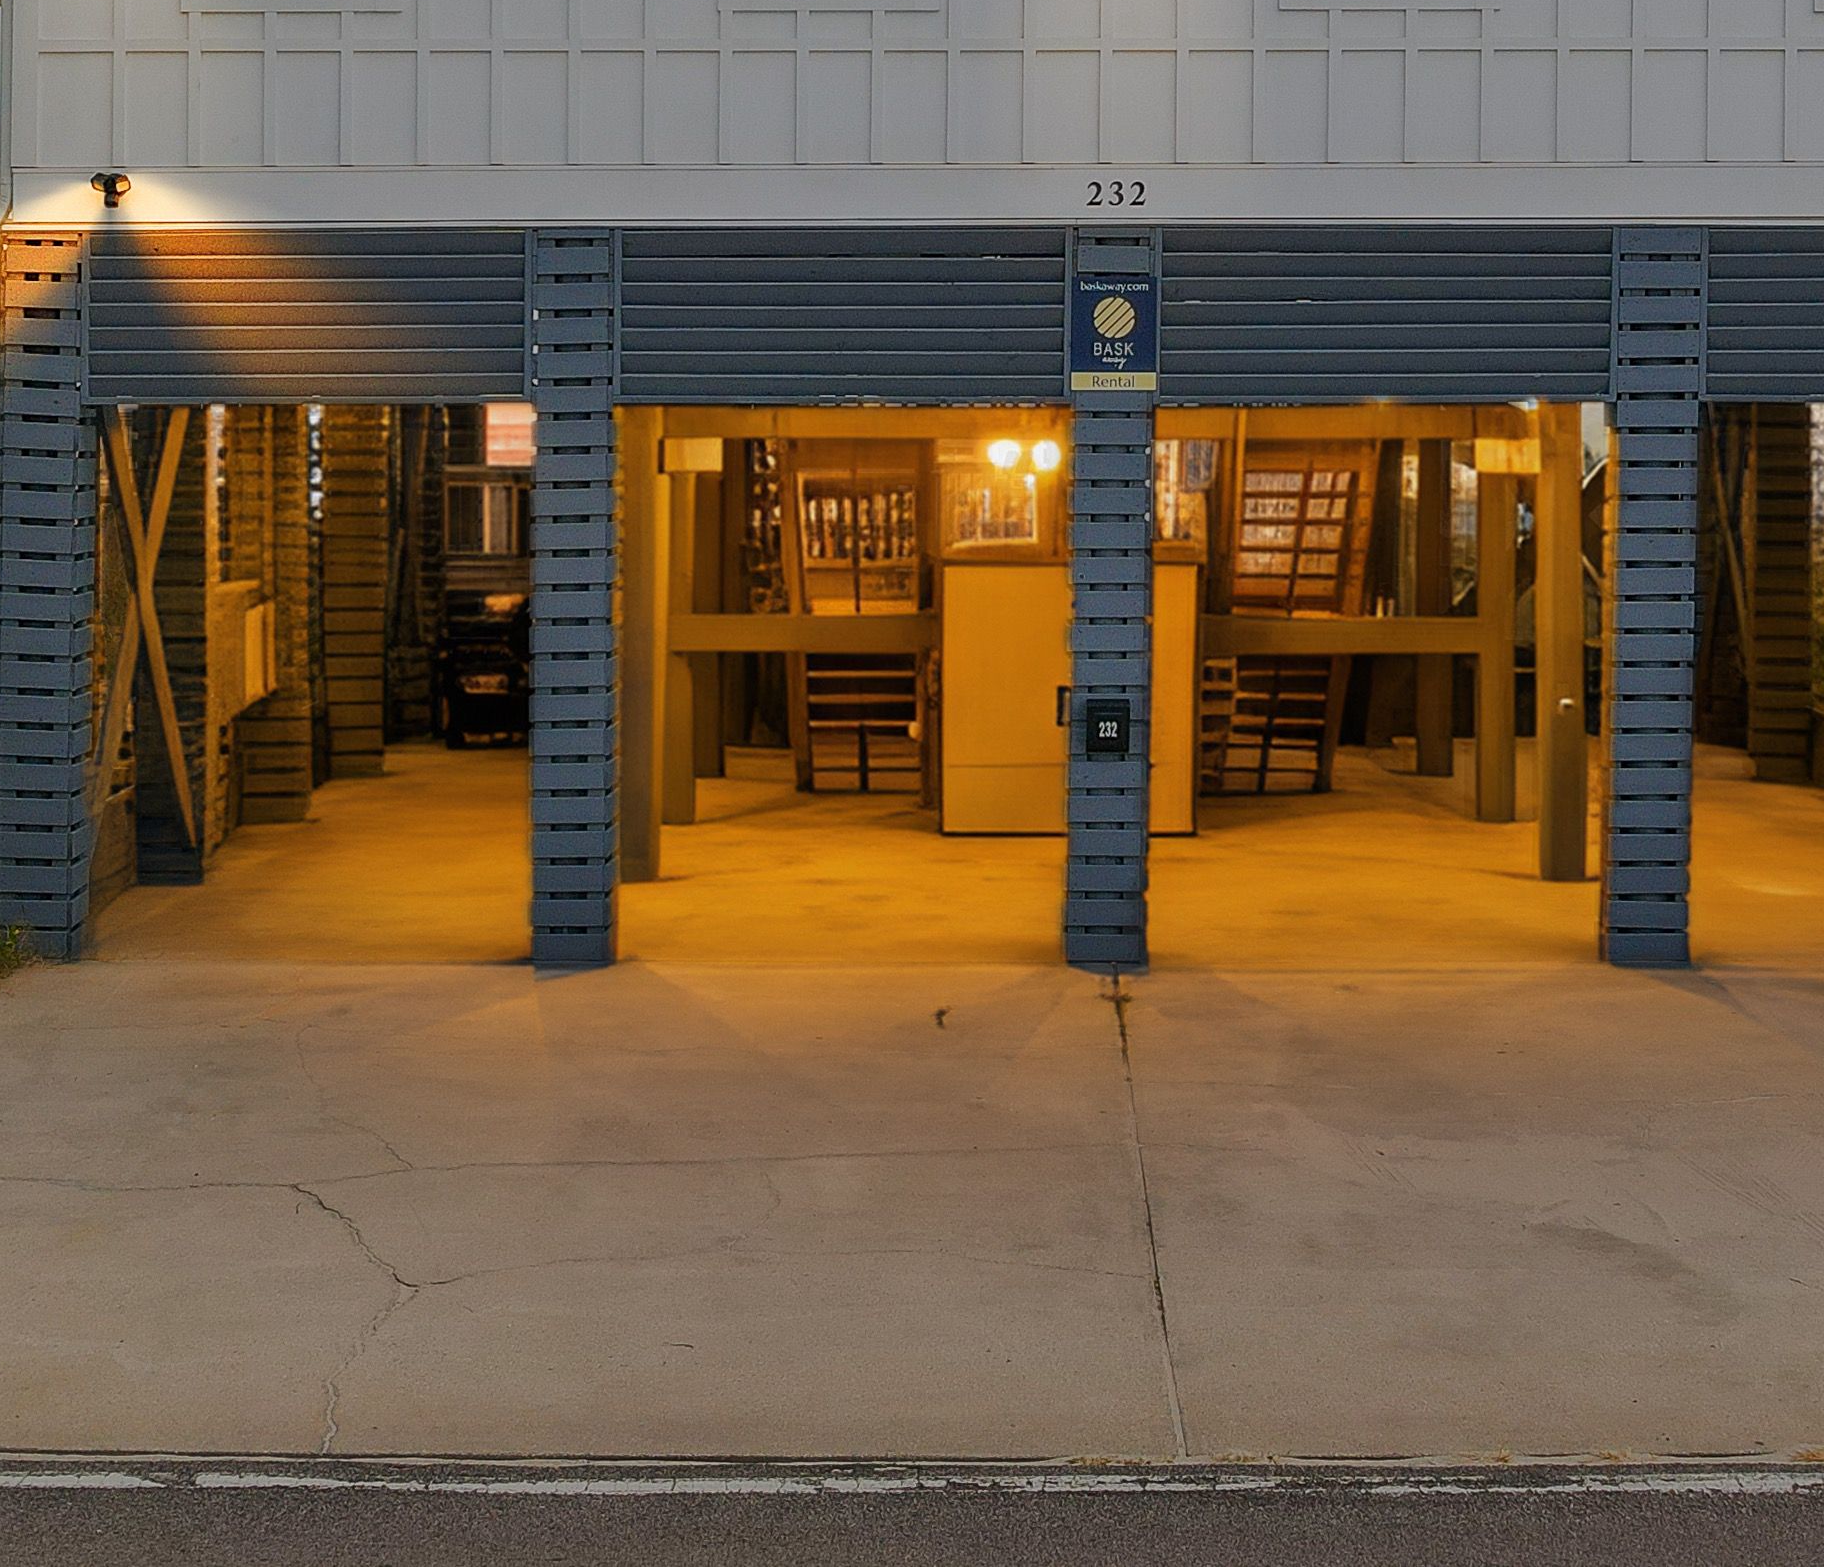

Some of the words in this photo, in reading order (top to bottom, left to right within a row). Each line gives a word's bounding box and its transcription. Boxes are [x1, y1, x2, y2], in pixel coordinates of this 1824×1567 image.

[1086, 181, 1146, 206] 232
[1080, 281, 1149, 293] baskaway.com
[1093, 342, 1134, 356] BASK
[1092, 375, 1135, 388] Rental
[1098, 721, 1118, 738] 232
